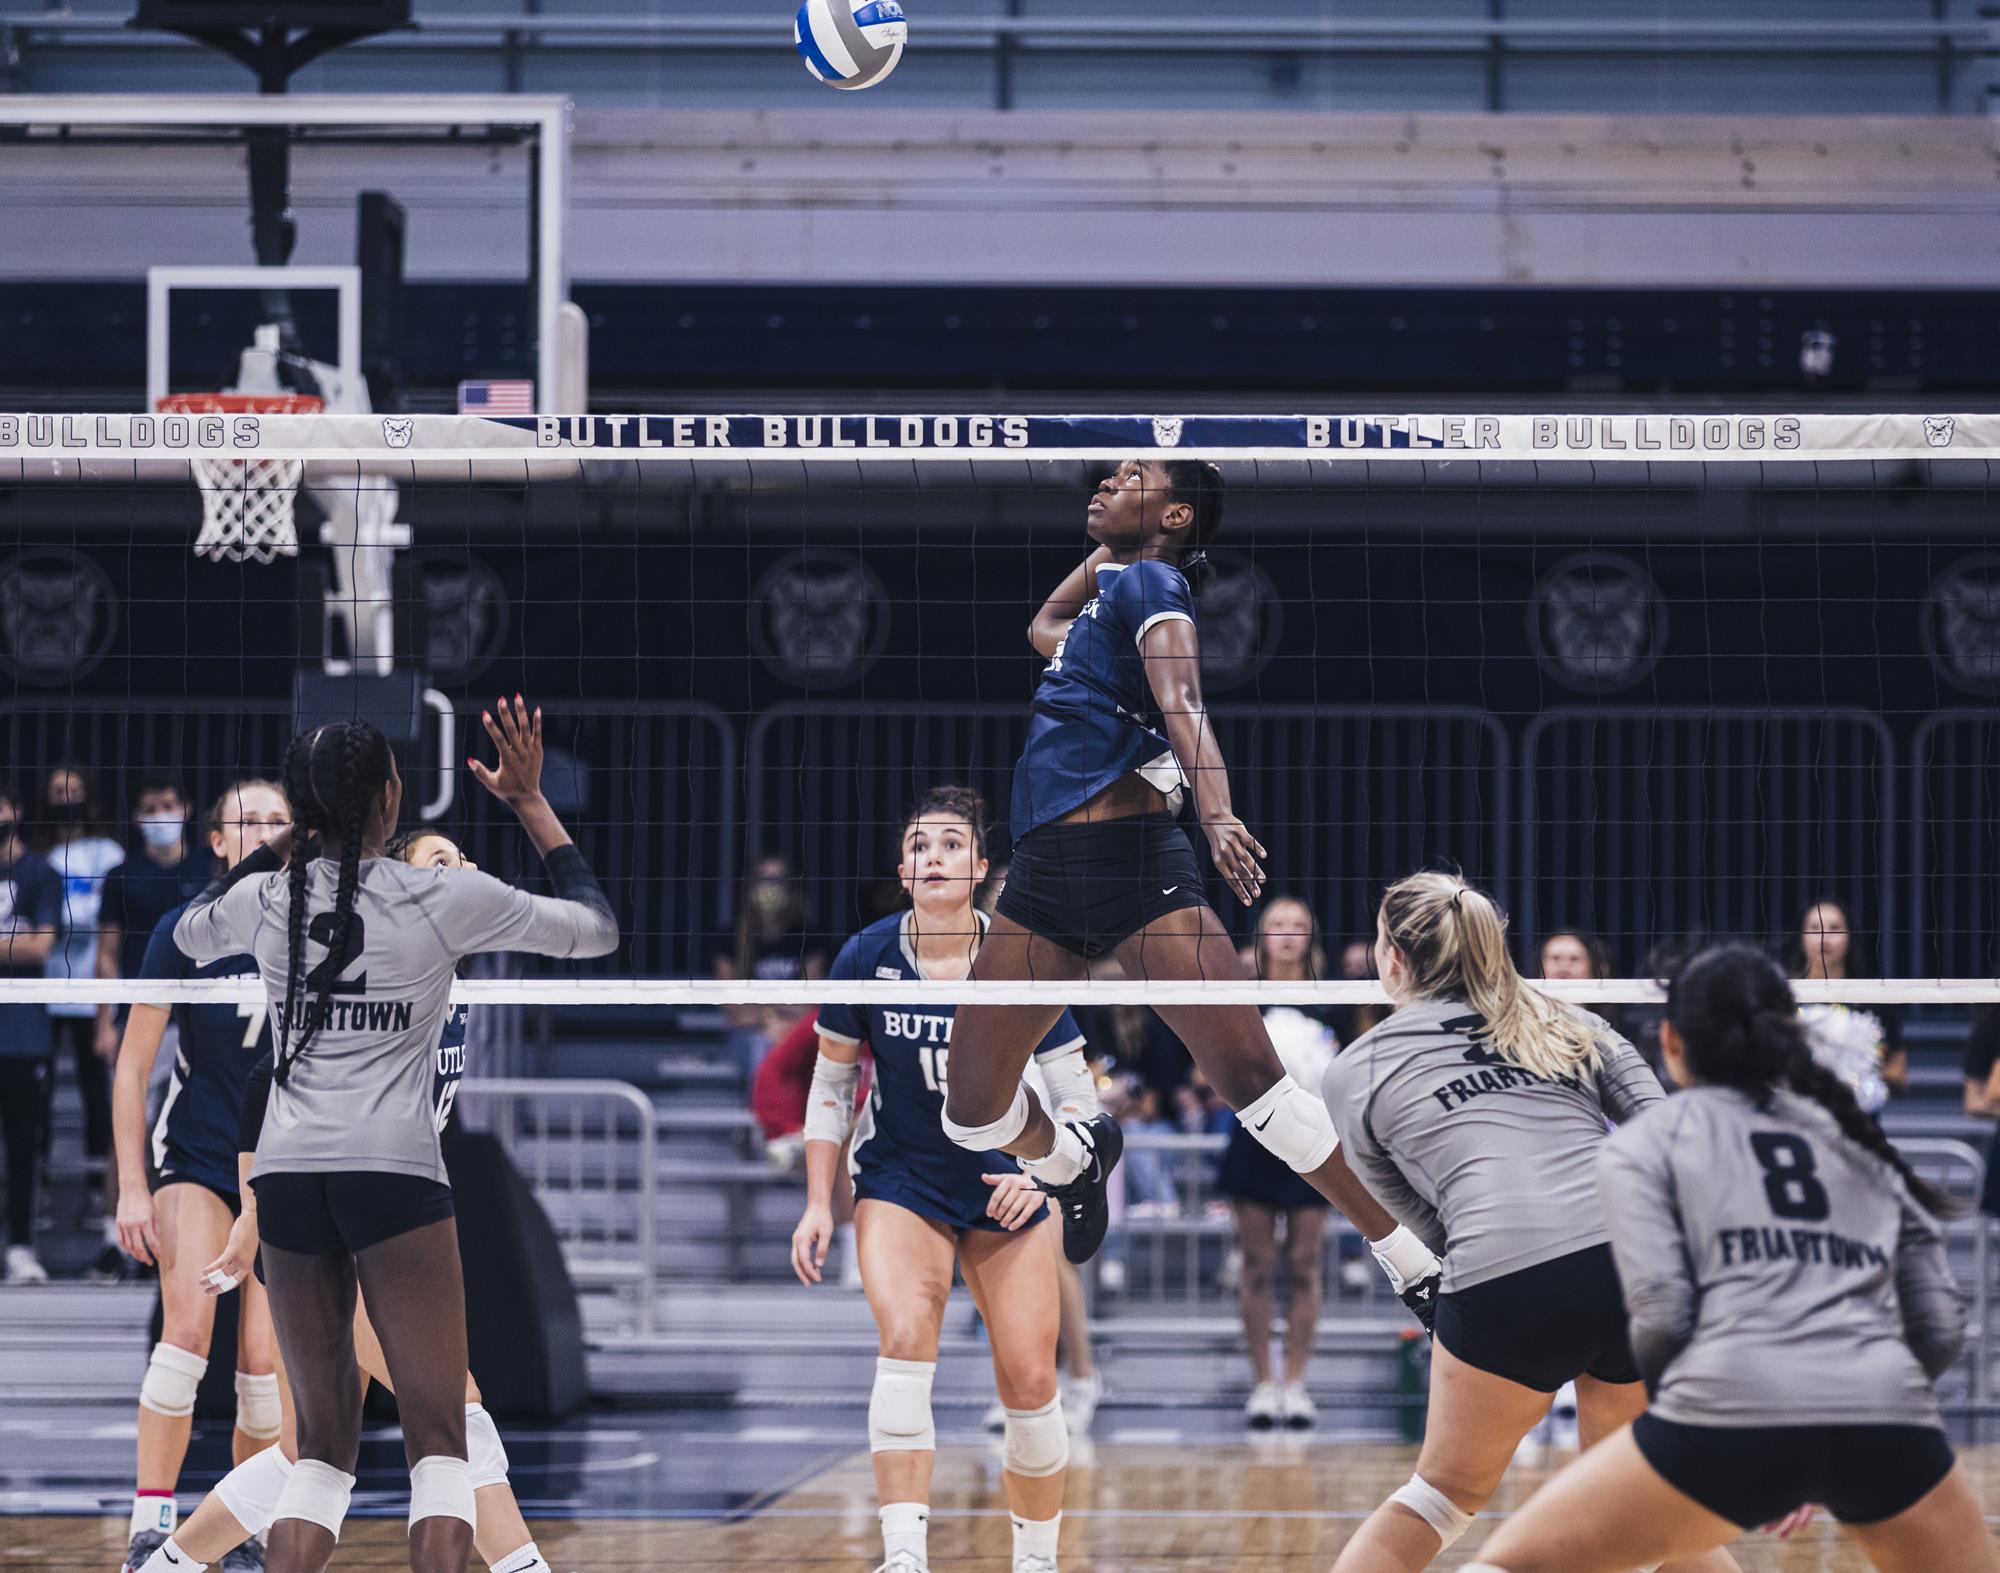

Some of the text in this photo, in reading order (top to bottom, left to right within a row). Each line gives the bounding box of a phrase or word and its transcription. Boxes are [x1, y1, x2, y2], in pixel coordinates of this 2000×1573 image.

[0, 416, 260, 448] BULLDOGS
[537, 416, 1029, 448] BUTLER BULLDOGS
[1307, 417, 1801, 450] BUTLER BULLDOGS
[305, 911, 367, 995] 2
[1750, 1131, 1831, 1223] 8
[1717, 1227, 1889, 1269] FRIARTOWN
